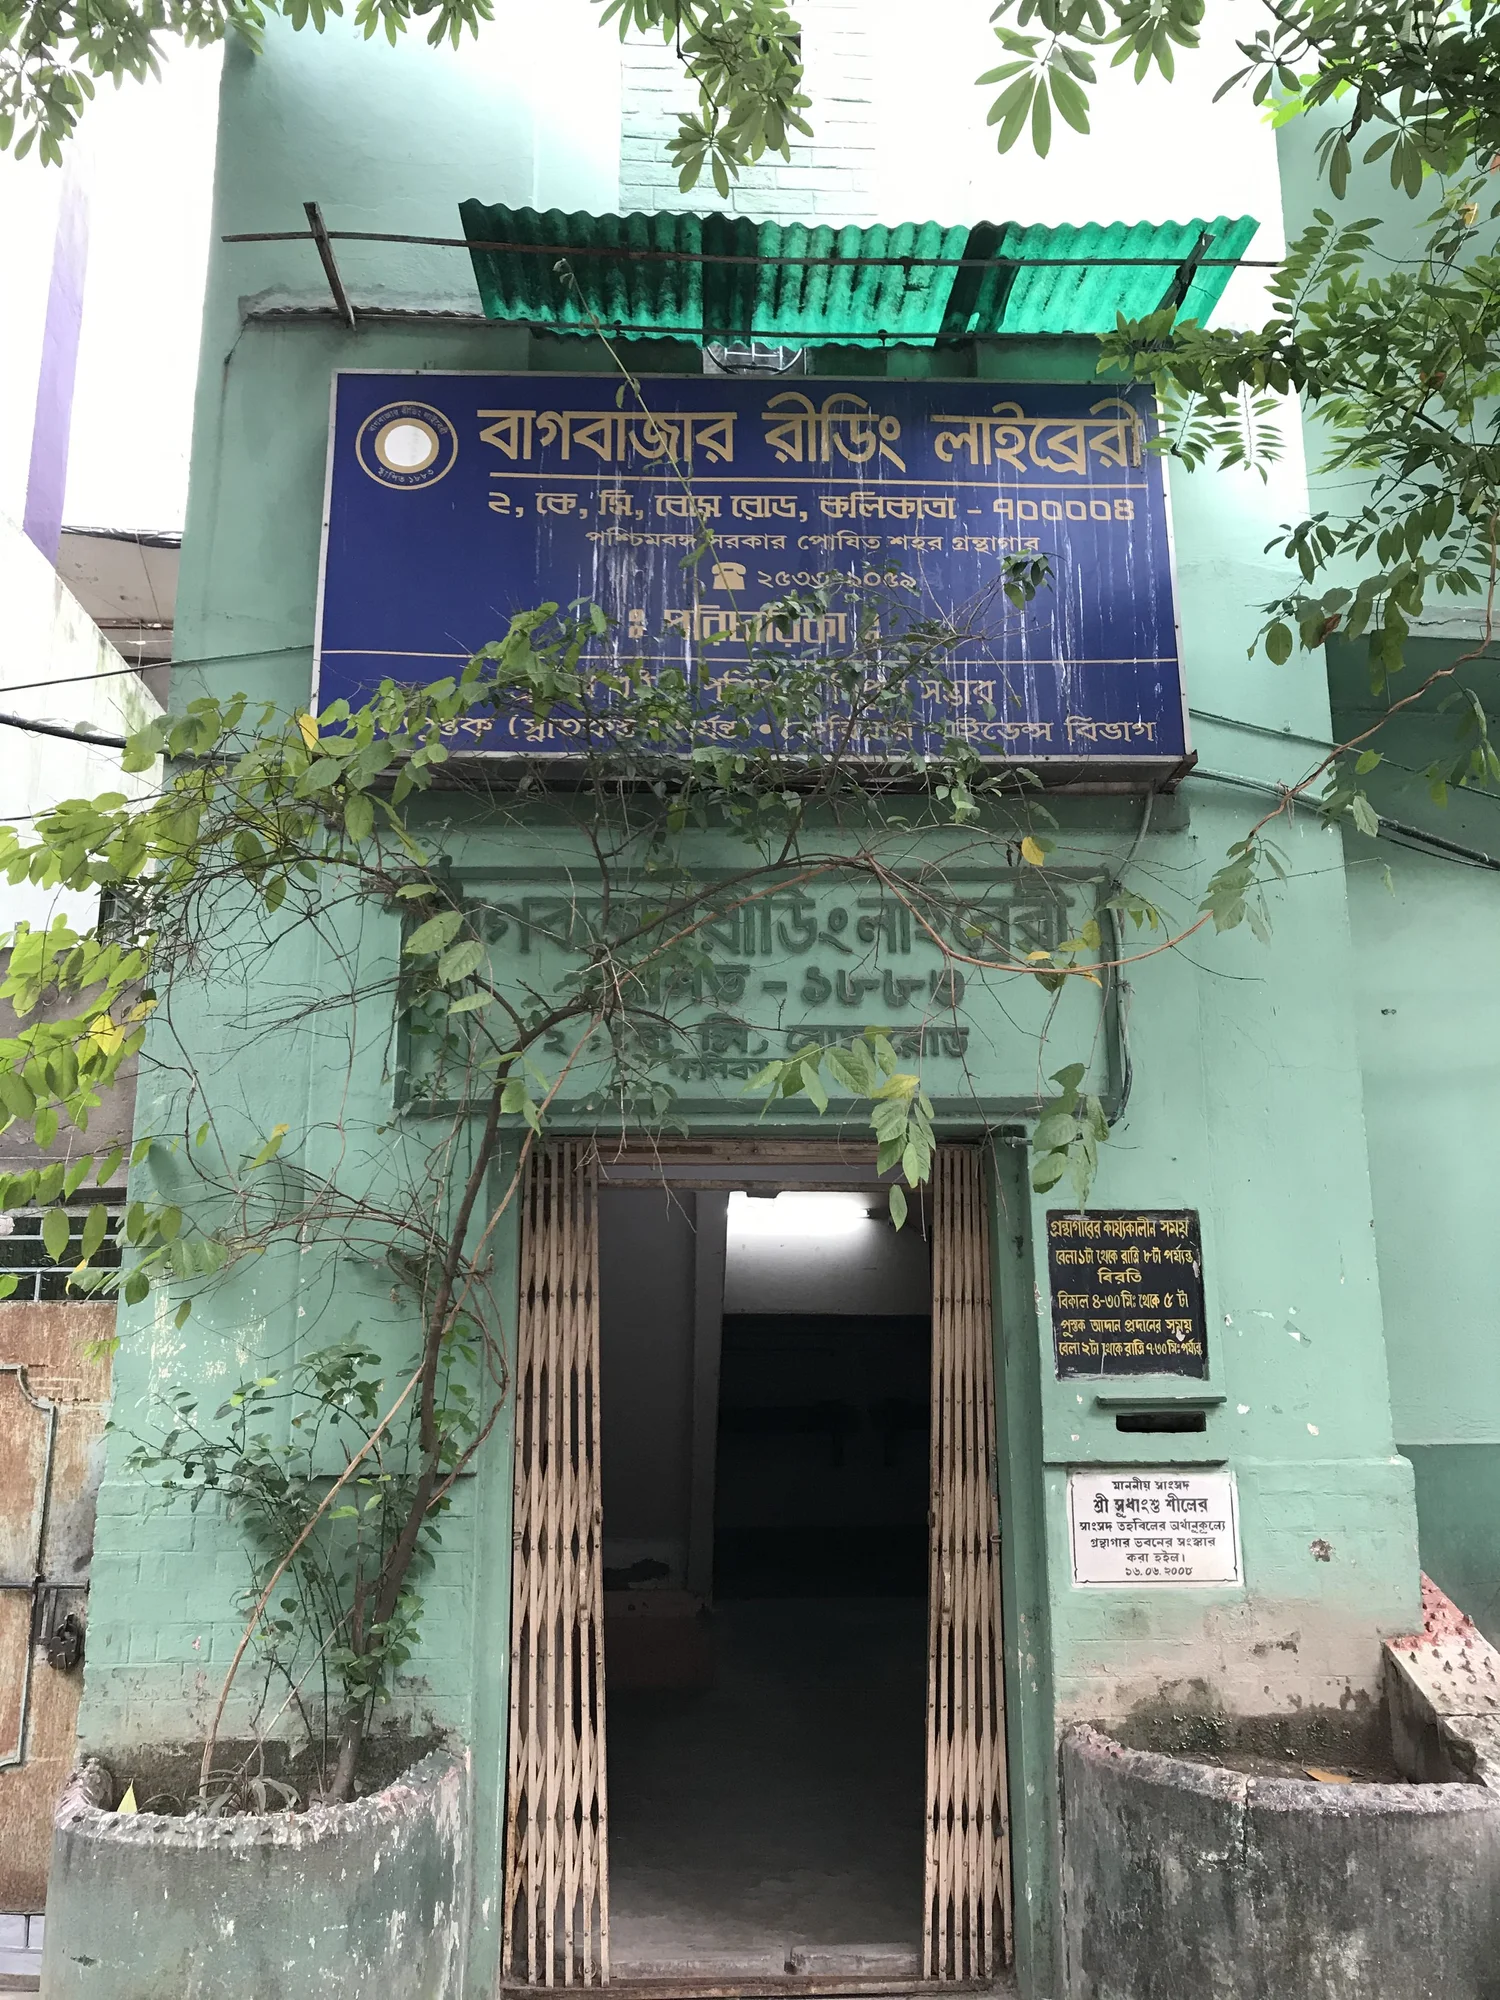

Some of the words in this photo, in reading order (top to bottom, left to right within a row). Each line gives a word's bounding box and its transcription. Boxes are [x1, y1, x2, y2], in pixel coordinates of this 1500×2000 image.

[477, 409, 738, 464] বাগবাজার
[761, 391, 906, 473] রীডিং
[930, 397, 1145, 475] লাইব্রেরী
[488, 492, 524, 518] ২,
[535, 492, 588, 520] কে,
[654, 495, 722, 518] বোস
[730, 495, 808, 522] রোড,
[818, 491, 957, 520] কলিকাতা
[992, 498, 1136, 521] ৭০০০০৪
[704, 534, 787, 549] সরকার
[797, 530, 882, 551] পোষিত
[887, 536, 943, 551] শহর
[952, 537, 1040, 555] গ্রন্থাগার
[1063, 715, 1157, 743] বিভাগ
[801, 965, 966, 1007] ১৮৮৩
[1050, 1219, 1101, 1239] গ্রন্থাগারের
[1160, 1217, 1189, 1239] সময়
[1095, 1249, 1118, 1265] থেকে
[1120, 1245, 1140, 1265] রাত্রি
[1143, 1246, 1161, 1265] ৮টা
[1097, 1267, 1142, 1284] বিরতি
[1057, 1289, 1090, 1309] বিকাল
[1092, 1294, 1120, 1309] ৪-৩০
[1138, 1293, 1160, 1309] থেকে
[1060, 1319, 1086, 1338] পুস্তক
[1089, 1319, 1121, 1332] আদান
[1124, 1319, 1161, 1334] প্রদানের
[1164, 1319, 1192, 1334] সময়
[1101, 1342, 1123, 1357] থেকে
[1123, 1338, 1145, 1356] রাত্রি
[1112, 1476, 1150, 1491] মাননীয়
[1154, 1480, 1190, 1491] সাংসদ
[1093, 1493, 1109, 1514] শ্রী
[1114, 1498, 1160, 1518] সুধাংশু
[1165, 1493, 1208, 1514] শীলের
[1079, 1521, 1113, 1532] সাংসদ
[1116, 1518, 1166, 1532] তহবিলের
[1090, 1537, 1130, 1549] গ্রন্থাগার
[1134, 1537, 1173, 1548] ভবনের
[1176, 1537, 1216, 1548] সংস্কার
[1126, 1553, 1149, 1564] করা
